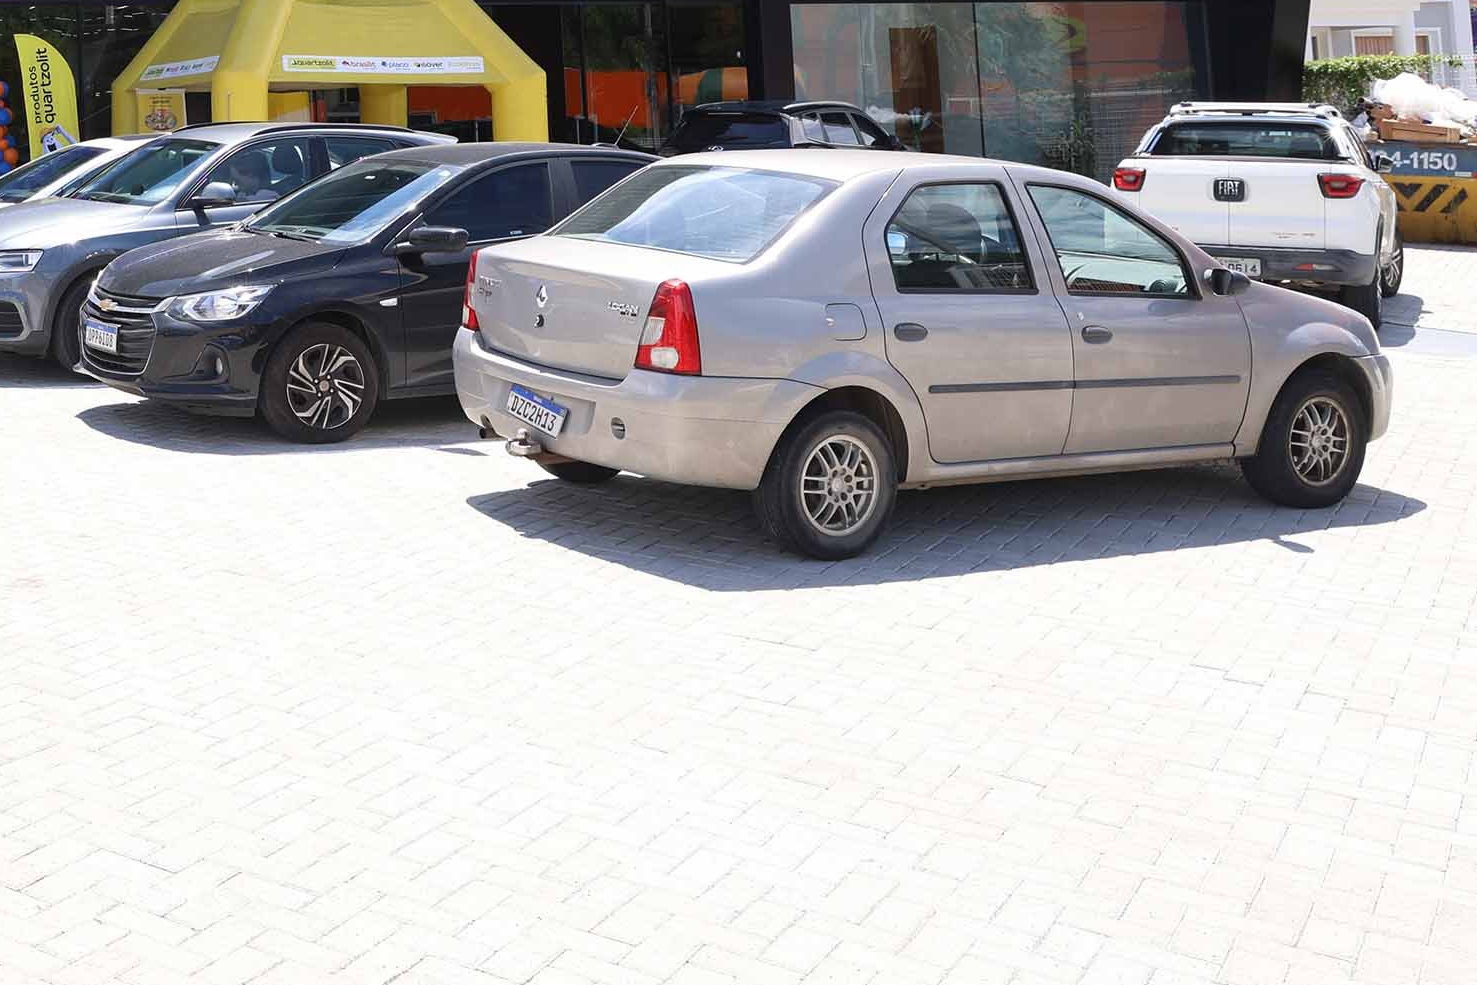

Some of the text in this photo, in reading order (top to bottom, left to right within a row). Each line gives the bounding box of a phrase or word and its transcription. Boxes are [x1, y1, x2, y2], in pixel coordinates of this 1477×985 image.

[28, 65, 43, 125] produtos
[35, 47, 57, 124] quartzolit
[1219, 180, 1241, 196] FIAT
[510, 395, 557, 431] DZC2H13
